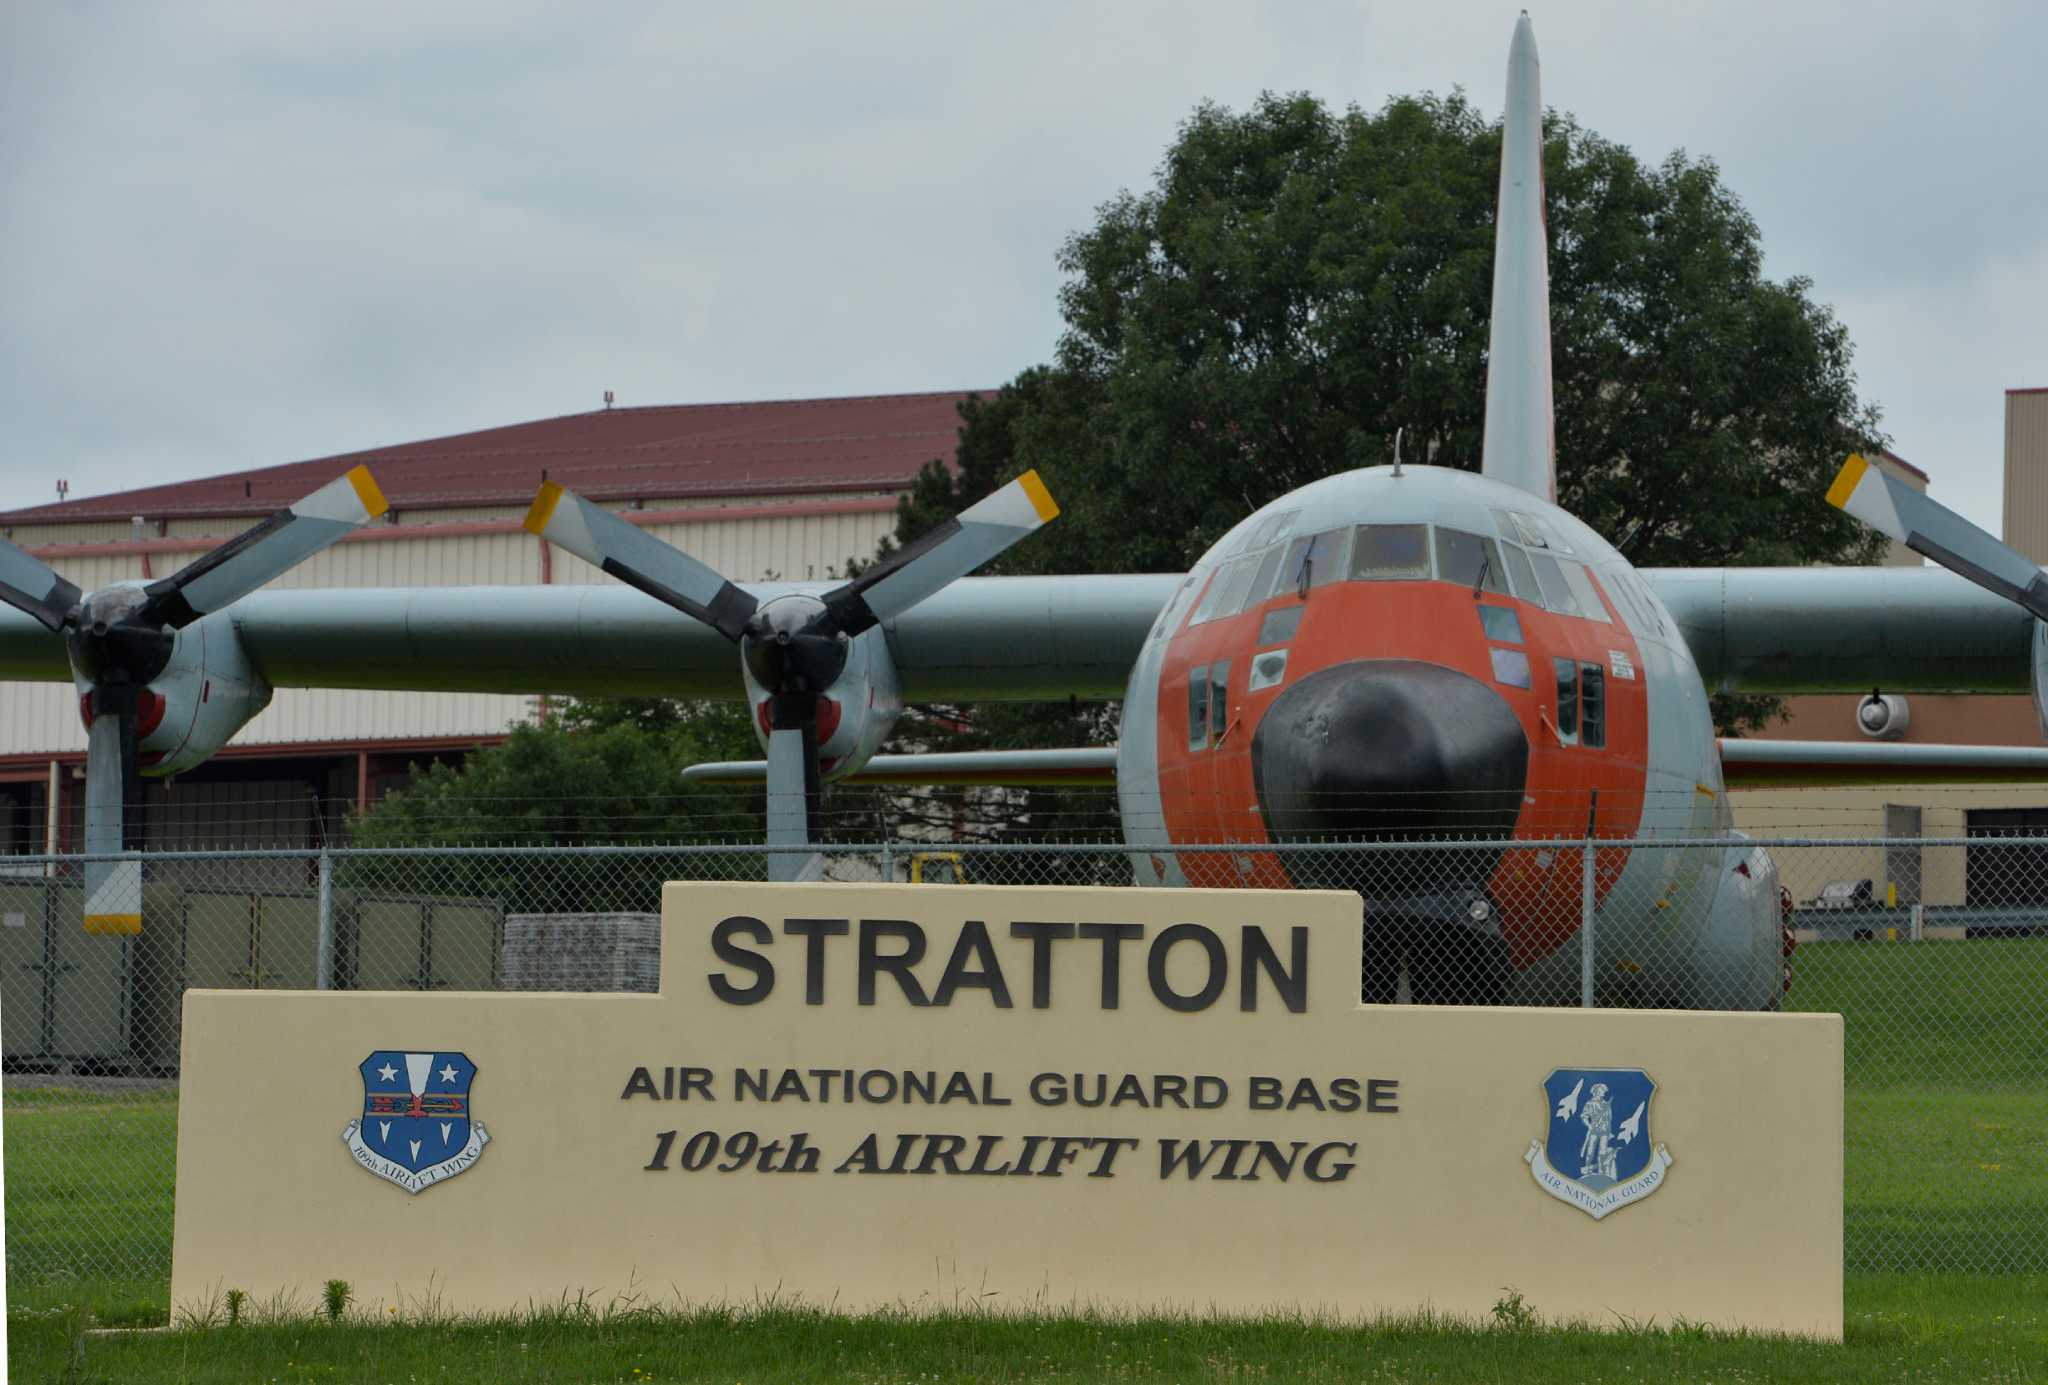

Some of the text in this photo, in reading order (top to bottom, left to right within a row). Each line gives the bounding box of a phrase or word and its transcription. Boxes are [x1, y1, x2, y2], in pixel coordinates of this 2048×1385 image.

[707, 916, 1309, 1014] STRATTON
[620, 1067, 1399, 1114] AIR NATIONAL GUARD BASE
[355, 1145, 478, 1188] 109th AIRLIFT WING
[643, 1130, 1358, 1184] 109th AIRLIFT WING
[1540, 1171, 1659, 1210] AIR NATIONAL GUARD
